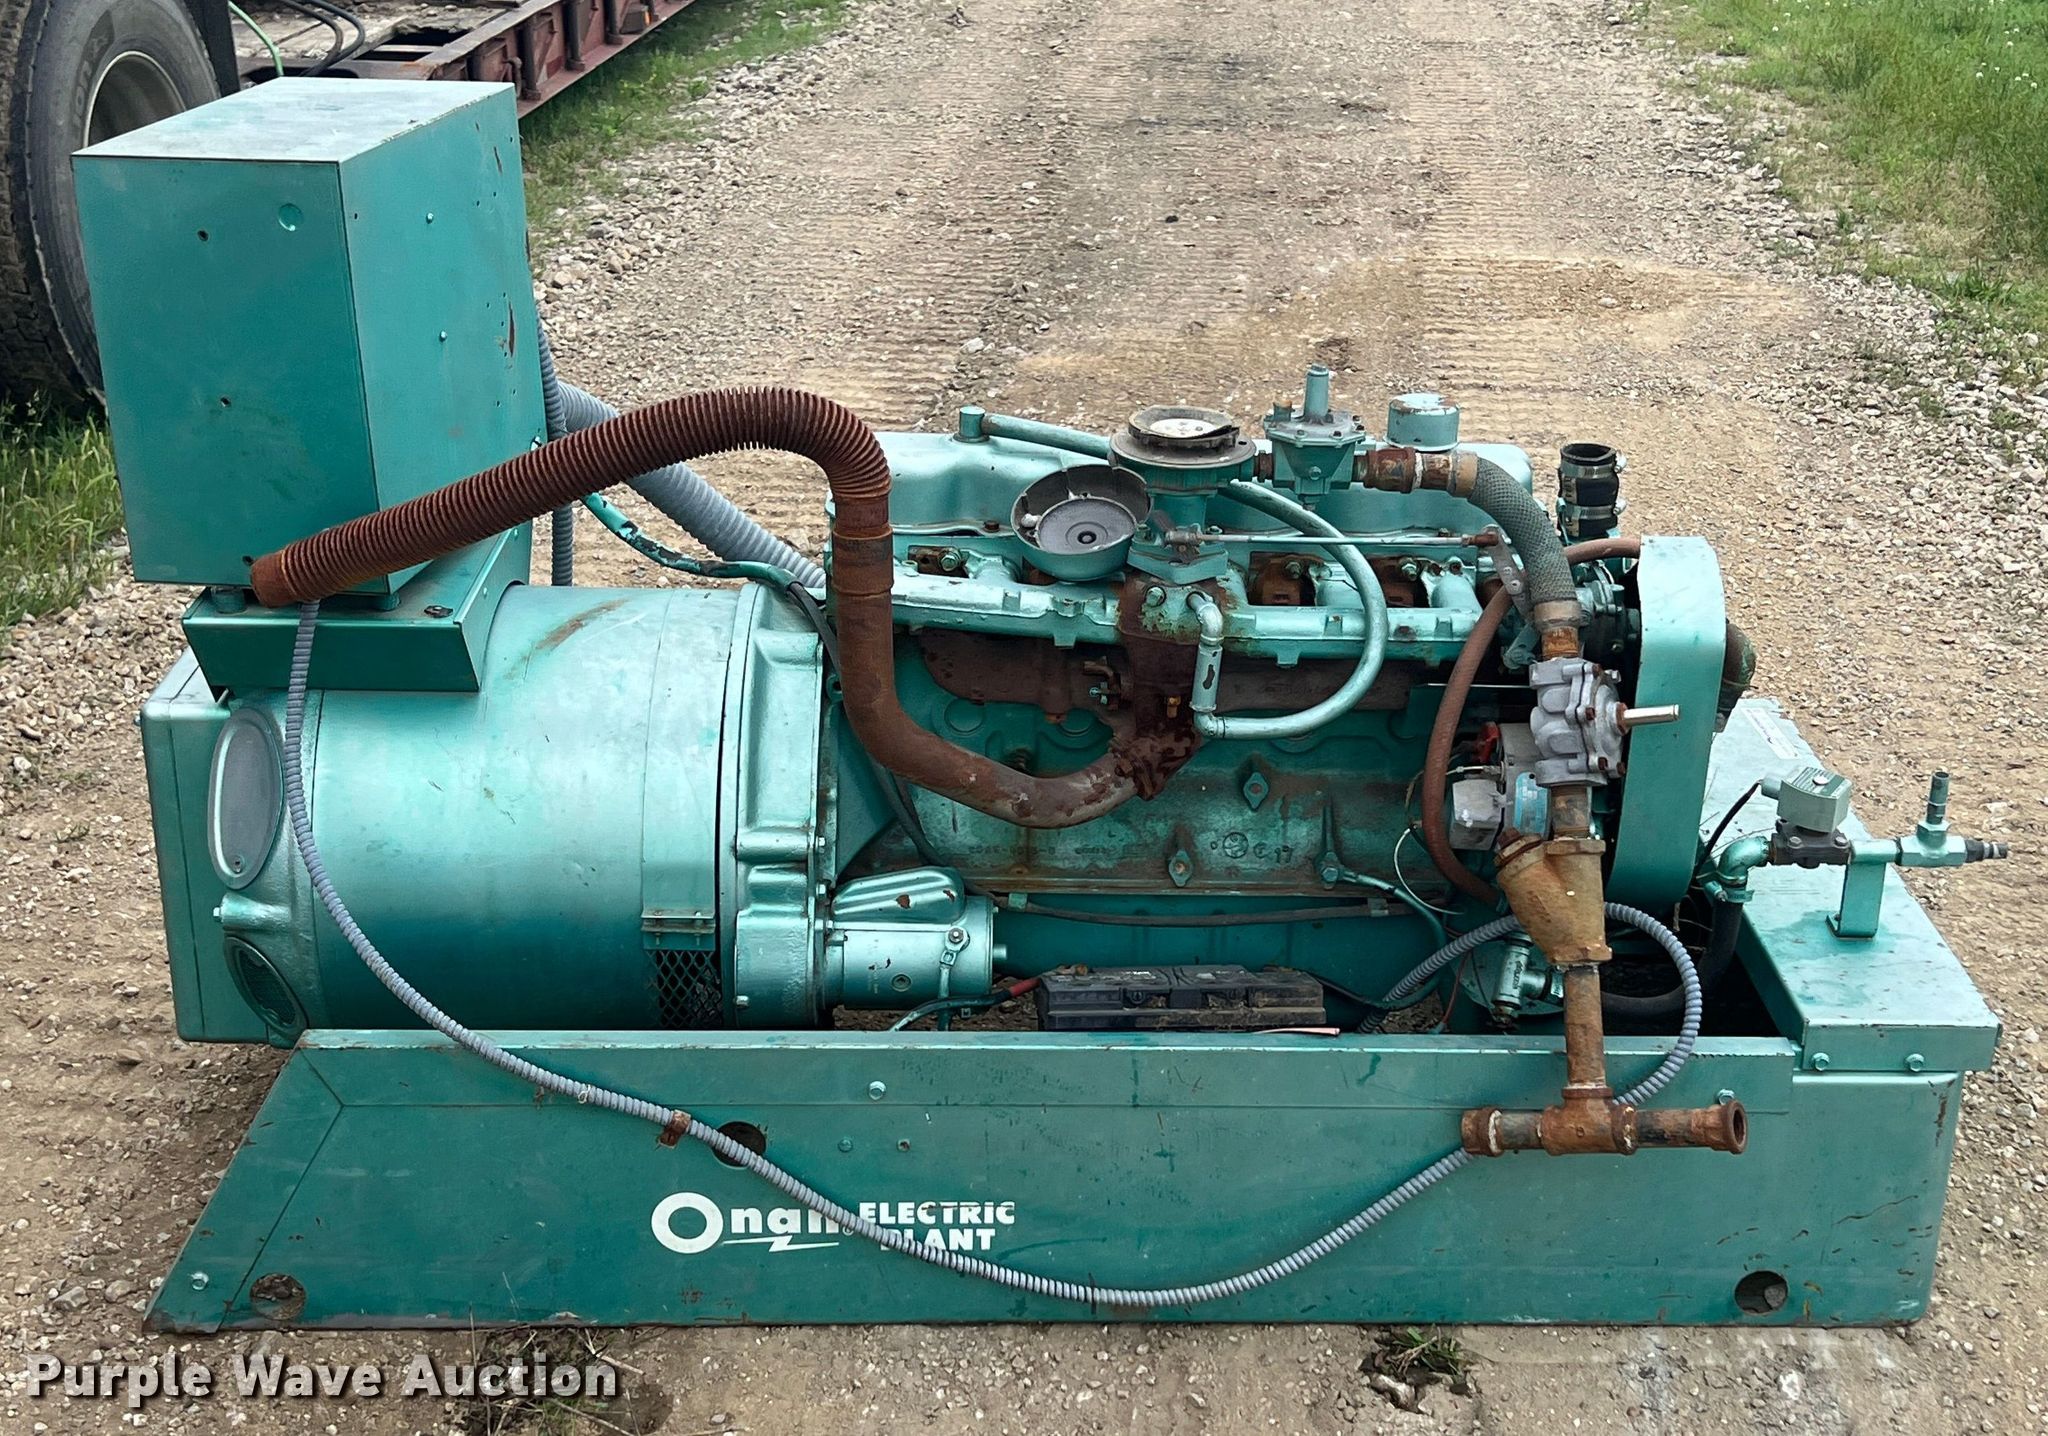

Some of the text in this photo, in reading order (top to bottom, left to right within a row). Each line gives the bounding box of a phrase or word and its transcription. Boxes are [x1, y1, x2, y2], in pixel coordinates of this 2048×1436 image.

[651, 1191, 840, 1254] Onan
[859, 1201, 1015, 1225] ELECTRIC
[880, 1228, 996, 1251] ANT
